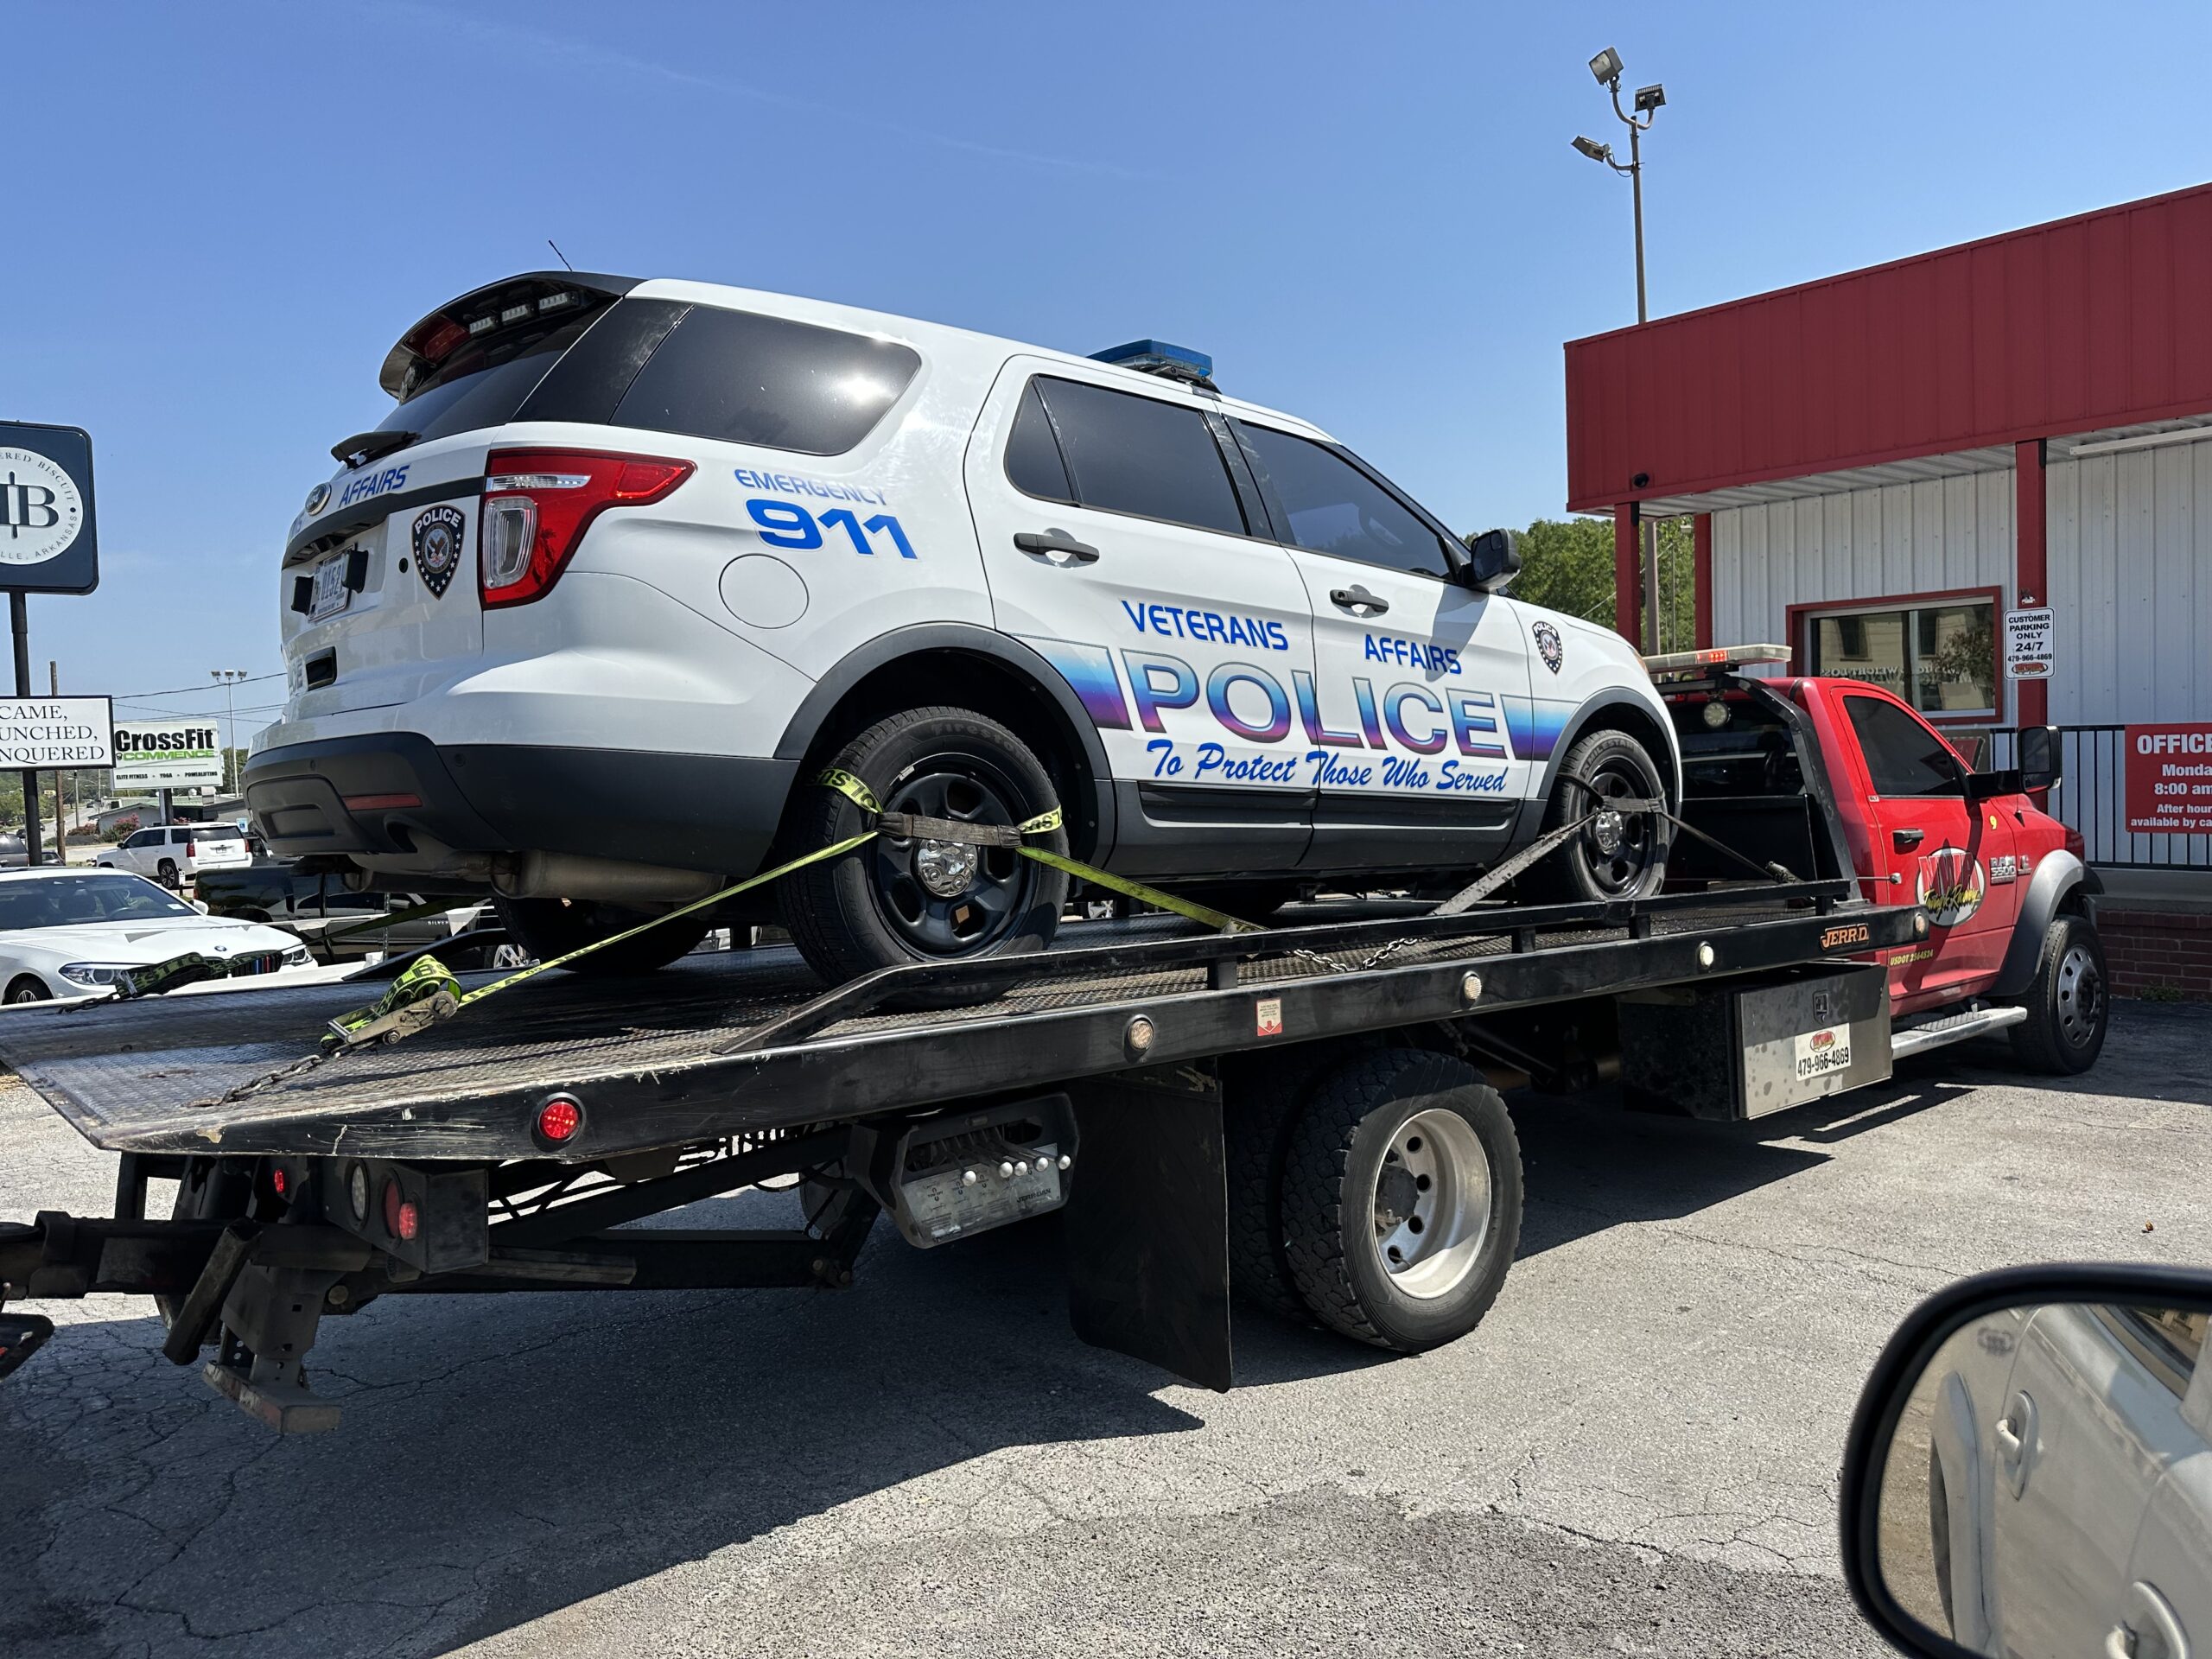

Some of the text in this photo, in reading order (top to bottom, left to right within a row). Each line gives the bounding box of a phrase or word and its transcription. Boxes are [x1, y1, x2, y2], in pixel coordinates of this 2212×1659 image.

[37, 461, 75, 502] BISCUIT
[338, 465, 411, 508] AFFAIRS
[734, 469, 887, 505] EMERGENCY
[414, 507, 462, 535] POLICE
[746, 499, 918, 560] 911
[35, 515, 78, 557] ARKANSAS
[1532, 622, 1558, 638] POLICE
[2008, 614, 2050, 624] CUSTOMER
[2009, 623, 2050, 632] PARKING
[1121, 601, 1462, 675] VETERANS AFFAIRS
[2015, 641, 2044, 652] 24/7
[1120, 648, 1509, 760] POLICE
[115, 728, 214, 752] CrossFit
[123, 750, 215, 761] COMMENCE
[1147, 739, 1509, 791] To Protect Those Who Served
[2154, 783, 2188, 795] 8:00
[2157, 804, 2184, 813] After
[2131, 817, 2180, 827] available
[2183, 817, 2196, 829] by
[1797, 1046, 1849, 1077] 479-966-4869
